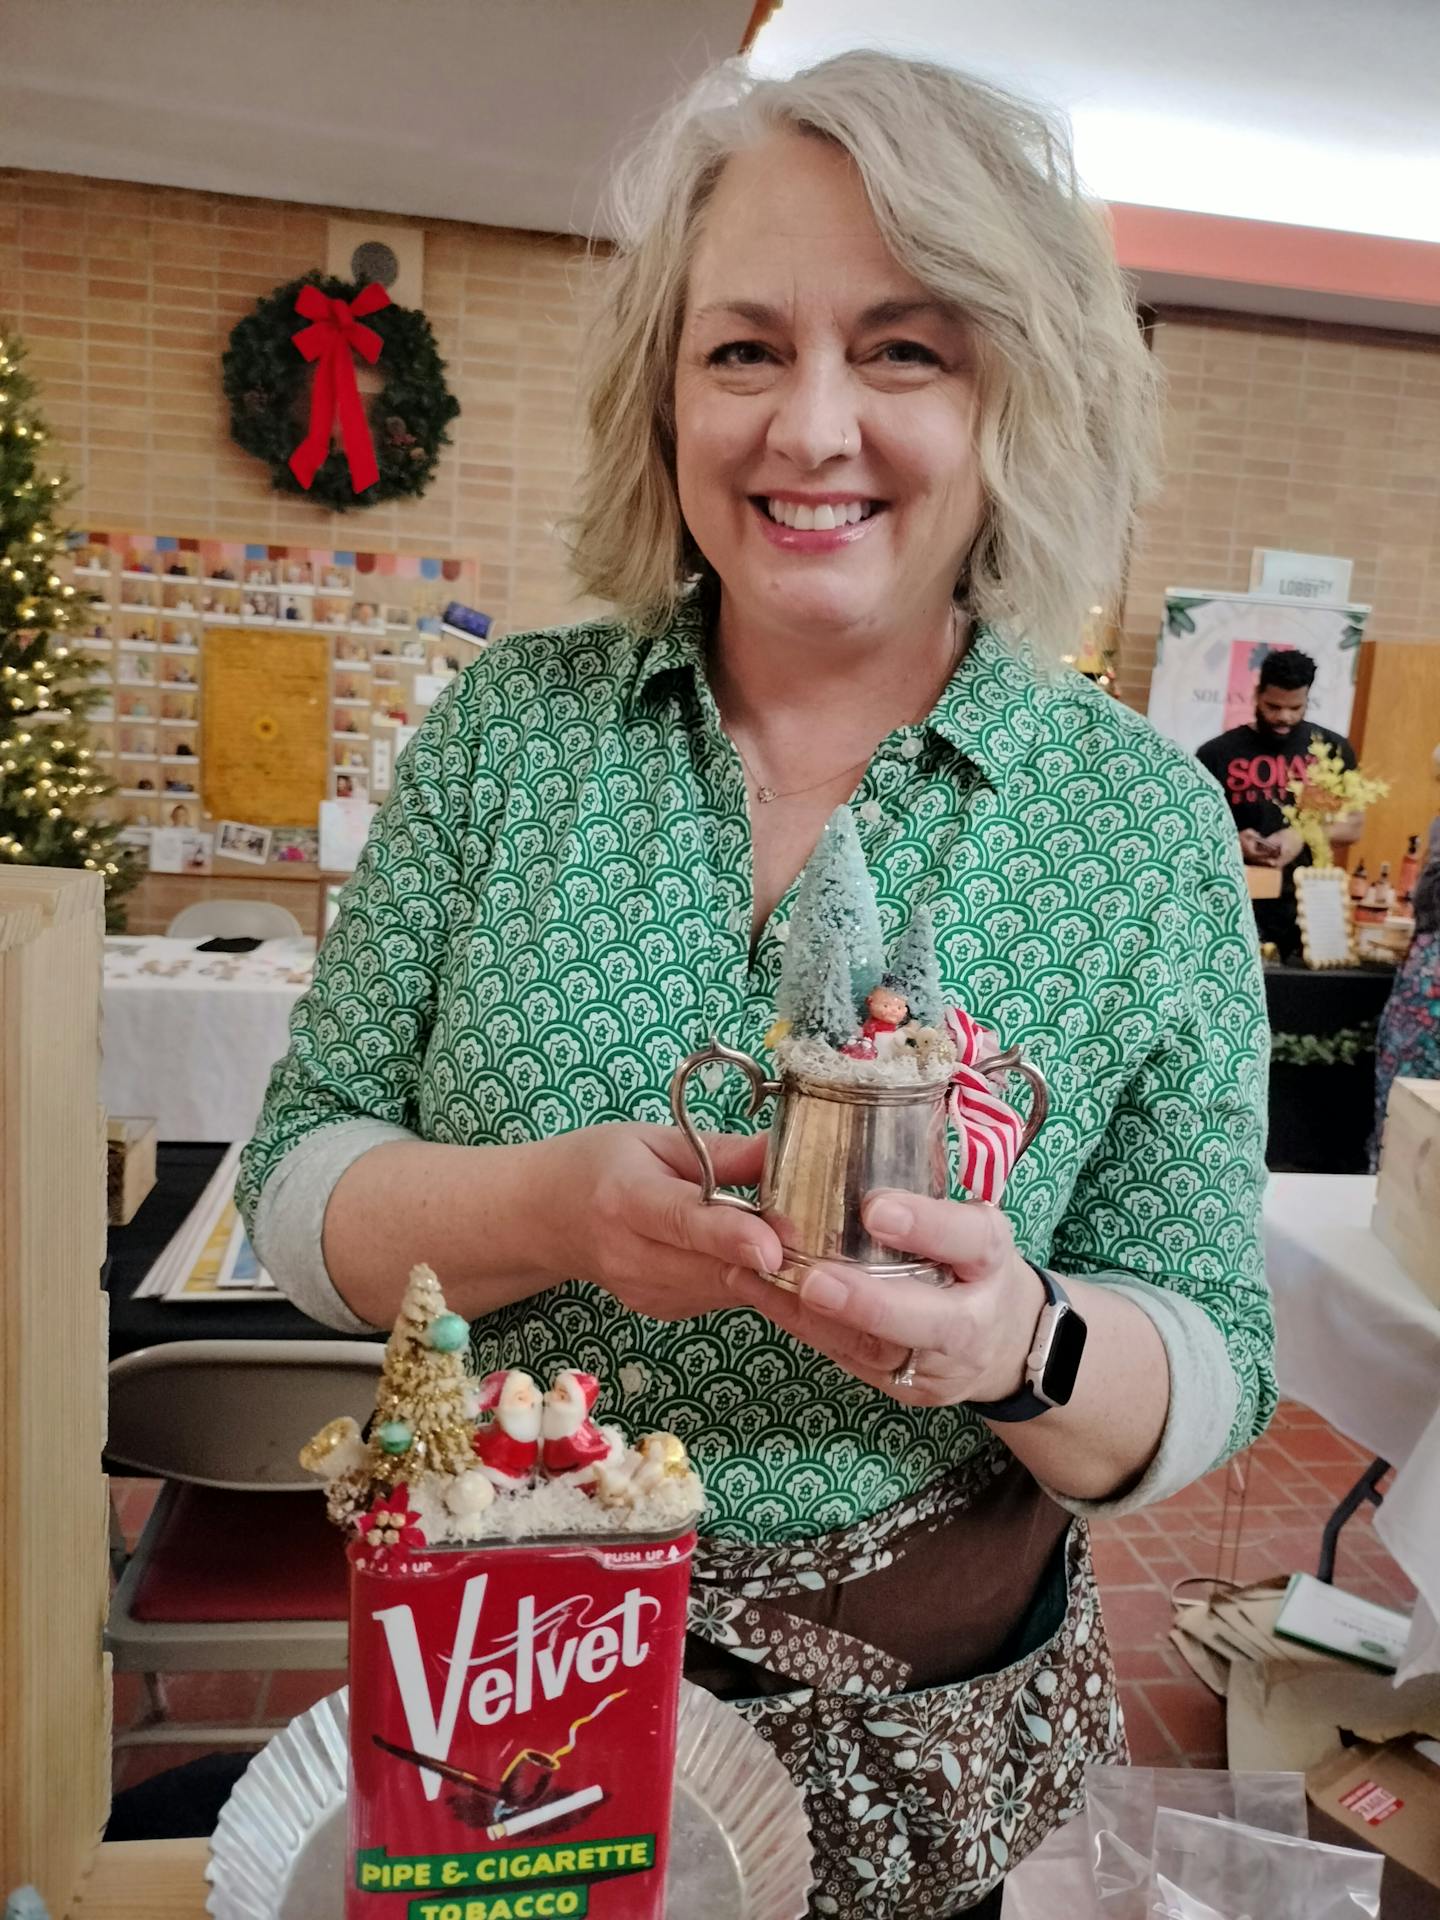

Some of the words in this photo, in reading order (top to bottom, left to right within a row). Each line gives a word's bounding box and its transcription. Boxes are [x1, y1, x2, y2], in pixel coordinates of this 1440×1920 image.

[411, 1560, 433, 1574] UP
[603, 1551, 642, 1564] PUSH
[645, 1549, 665, 1562] UP
[372, 1573, 661, 1802] Velvet
[361, 1862, 432, 1888] PIPE
[441, 1861, 469, 1886] &
[475, 1841, 648, 1882] CIGARETTE
[419, 1890, 579, 1920] TOBACCO
